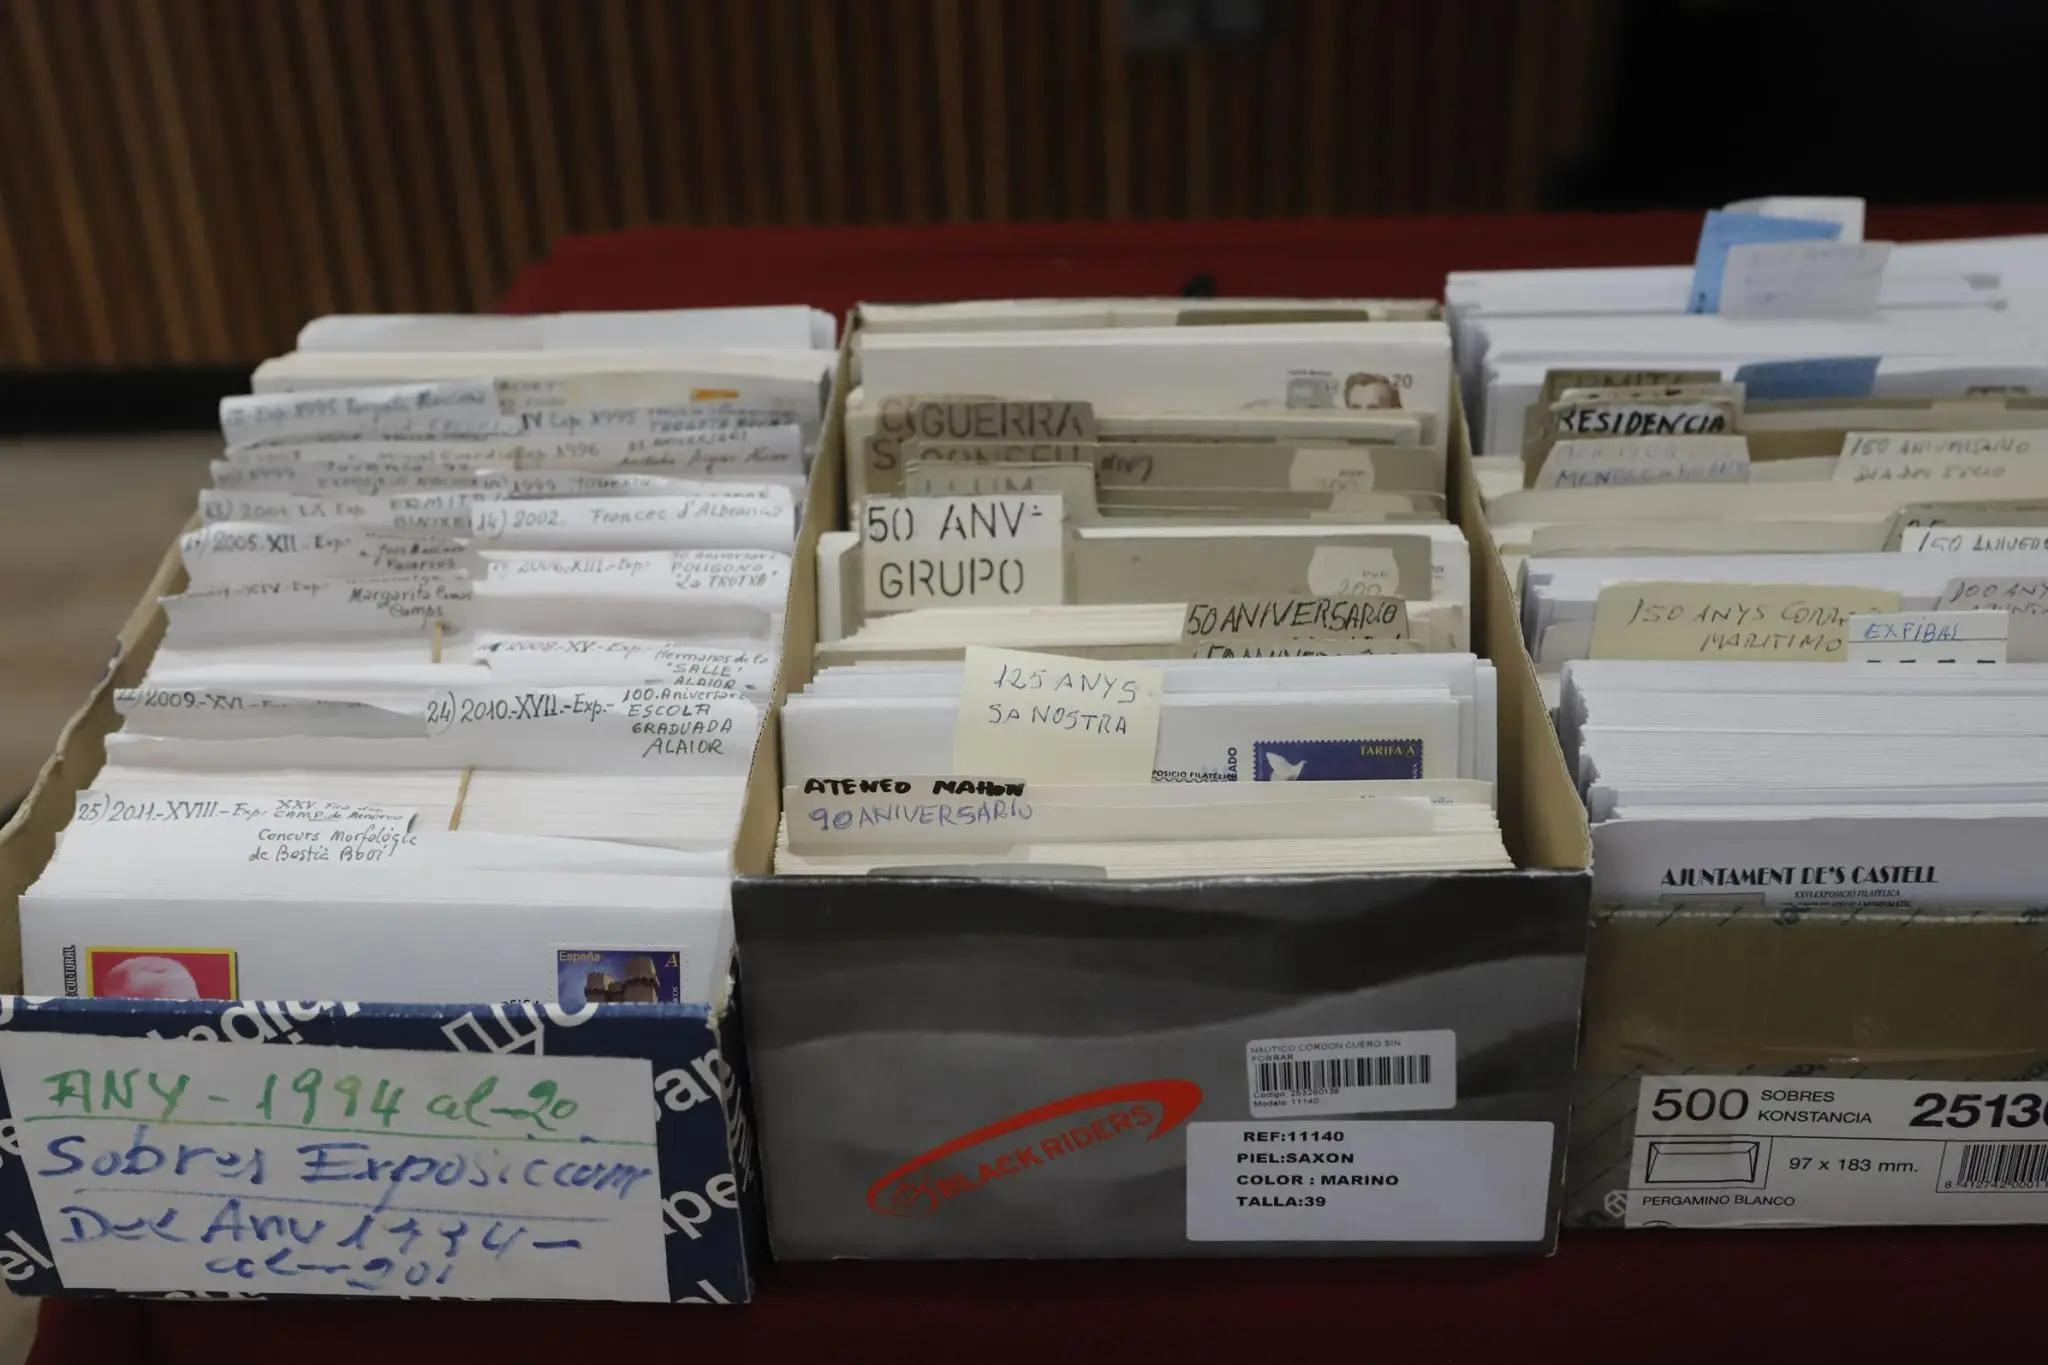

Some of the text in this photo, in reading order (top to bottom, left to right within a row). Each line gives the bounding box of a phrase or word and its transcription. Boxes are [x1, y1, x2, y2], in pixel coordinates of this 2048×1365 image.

[920, 403, 1083, 438] GUERRA
[868, 506, 914, 543] 50
[879, 557, 1024, 599] GRUPO
[1219, 599, 1398, 633] ANIVERSARIO
[1700, 632, 1842, 653] MARITIMO
[993, 664, 1137, 704] 125 ANYS
[1032, 704, 1128, 735] NOSTRA
[642, 737, 724, 758] ALAIOR
[804, 778, 912, 796] ATENEO
[1661, 867, 1796, 887] AJUNTAMENT
[1851, 866, 1940, 884] CASTELL
[559, 951, 678, 968] España A
[1344, 1040, 1382, 1050] CUERO
[1384, 1039, 1402, 1047] SIN
[41, 1068, 191, 1125] ANY
[256, 1067, 404, 1128] 1994
[1651, 1088, 1750, 1122] 500
[1761, 1090, 1836, 1103] SOBRES
[1757, 1109, 1873, 1124] KONSTANCIA
[1243, 1131, 1345, 1142] REF:11140
[934, 1103, 1155, 1200] BLACK RIDERS
[1236, 1152, 1355, 1164] PIEL:SAXON
[1788, 1156, 1816, 1171] 97
[1838, 1157, 1872, 1172] 183
[1236, 1175, 1304, 1186] COLOR
[1320, 1175, 1400, 1186] MARINO
[1236, 1197, 1327, 1208] TALLA:39
[1642, 1195, 1796, 1207] PERGAMINO BLANCO
